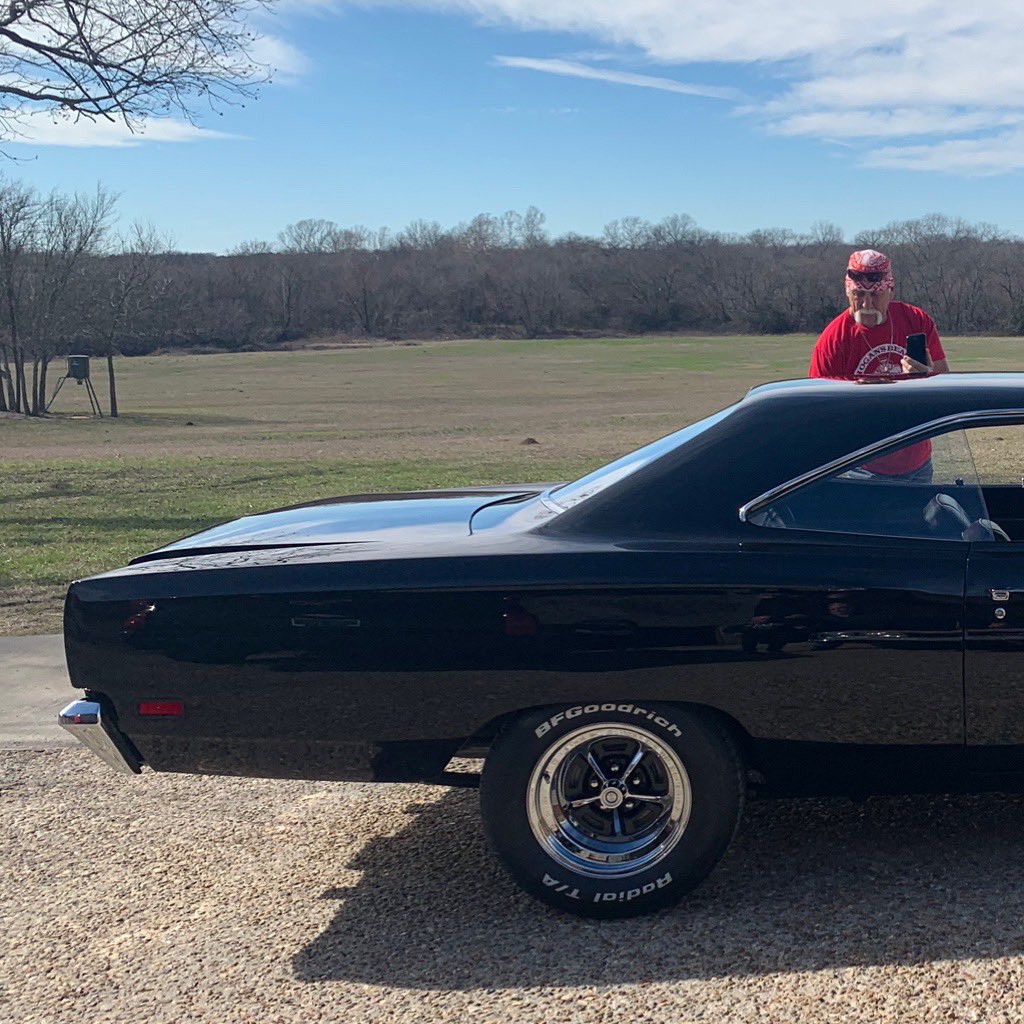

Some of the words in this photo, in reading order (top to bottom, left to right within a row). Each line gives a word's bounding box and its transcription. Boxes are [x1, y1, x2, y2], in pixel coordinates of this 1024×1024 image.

[535, 703, 682, 738] BFGoodrich
[542, 873, 581, 899] T/A
[593, 872, 672, 902] Radial
